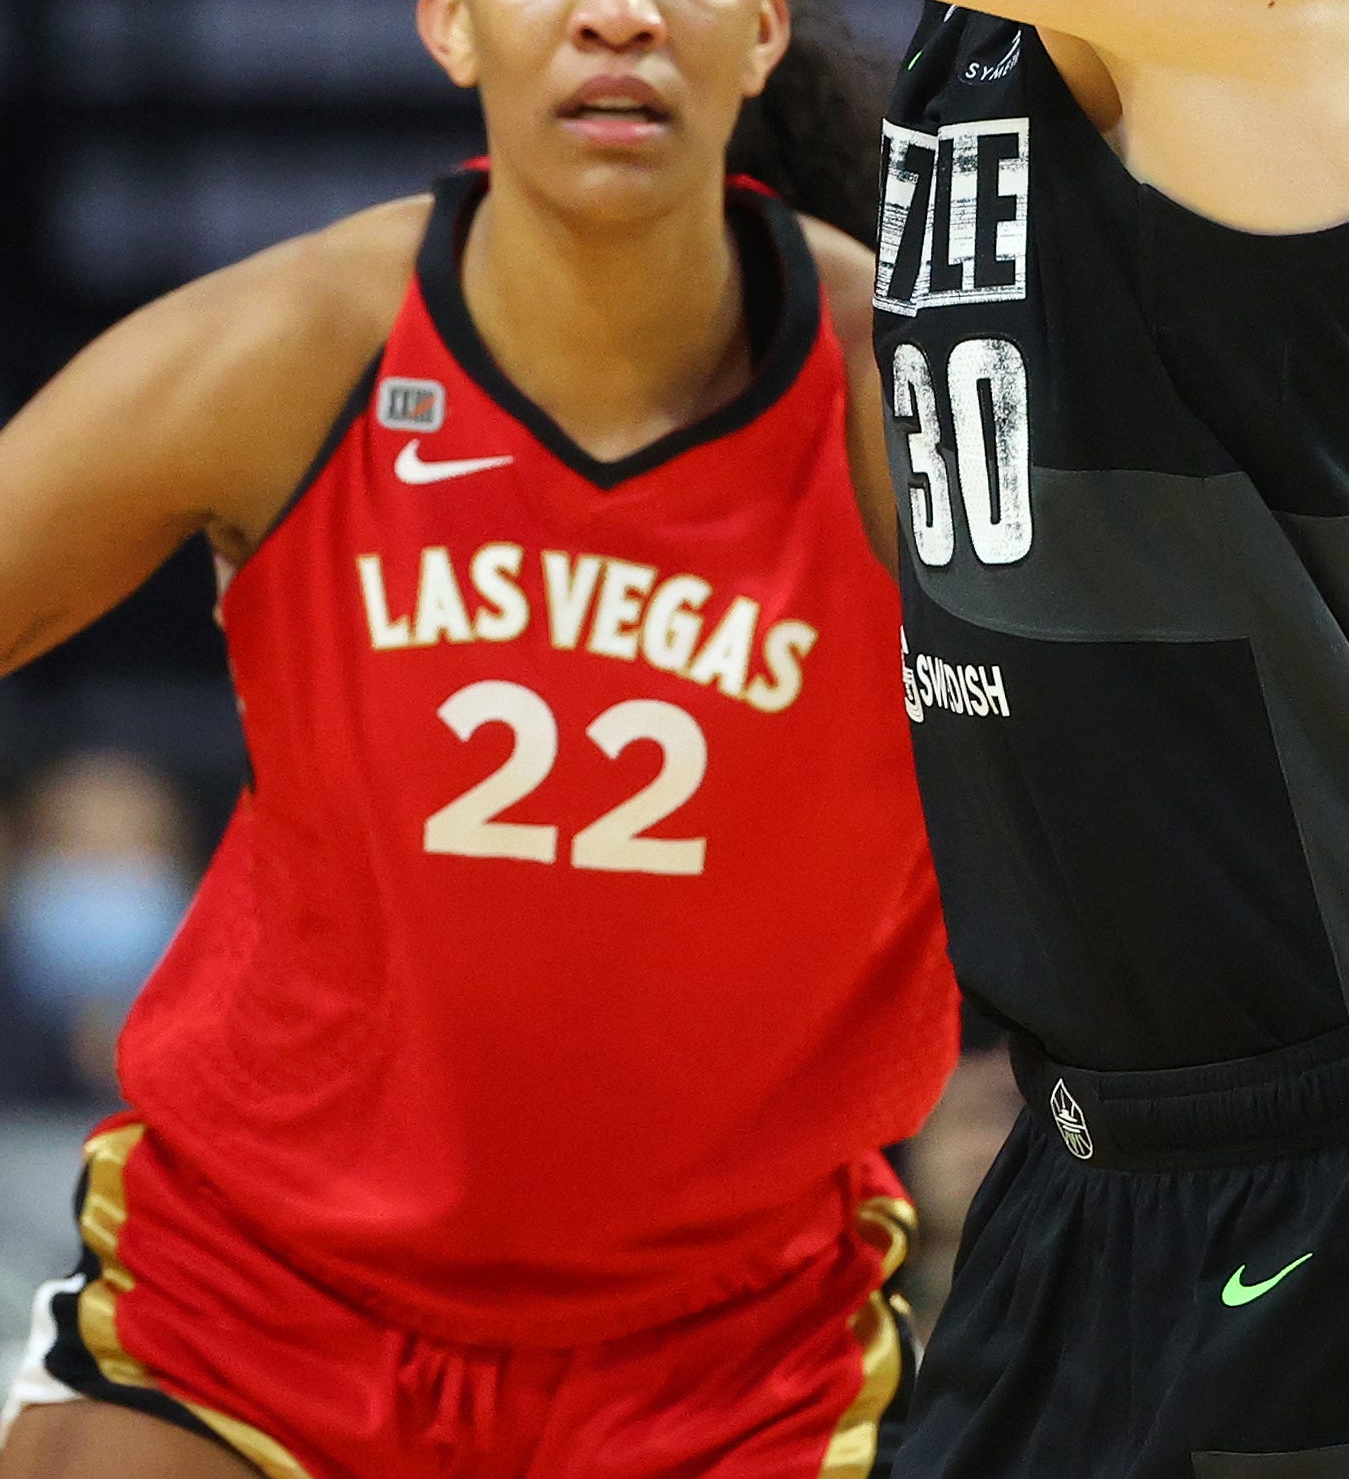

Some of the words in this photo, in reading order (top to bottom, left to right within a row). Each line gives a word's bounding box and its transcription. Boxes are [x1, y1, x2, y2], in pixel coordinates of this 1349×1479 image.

[893, 338, 1033, 567] 30
[356, 542, 530, 650] LAS
[541, 549, 818, 713] VEGAS
[422, 679, 708, 876] 22
